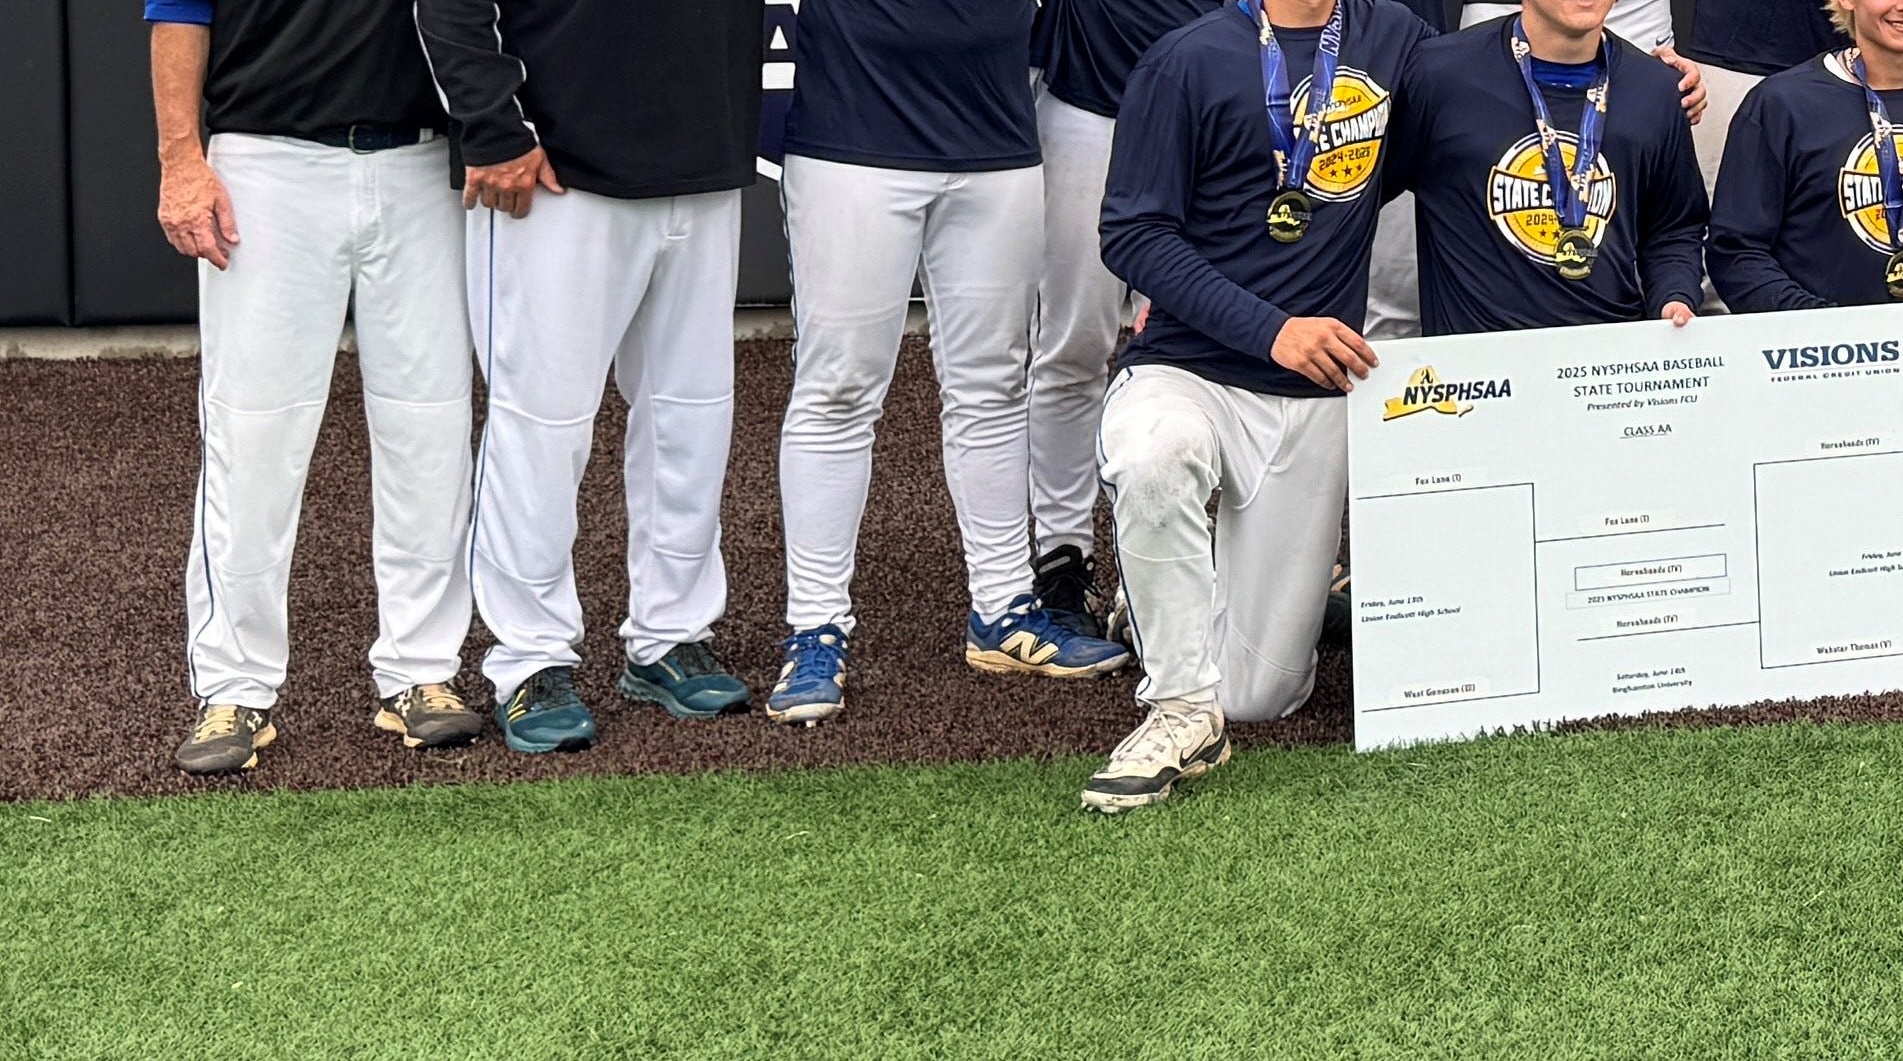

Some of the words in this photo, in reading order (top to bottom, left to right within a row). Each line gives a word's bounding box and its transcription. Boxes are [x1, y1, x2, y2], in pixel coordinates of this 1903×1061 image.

[1492, 179, 1540, 212] STATE
[1845, 177, 1881, 210] STAT
[1557, 365, 1587, 379] 2025
[1591, 360, 1660, 377] NYSPHSAA
[1663, 356, 1725, 371] BASEBALL
[1762, 340, 1900, 370] VISIONS
[1403, 379, 1512, 406] NYSPHSAA
[1574, 384, 1613, 398] STATE
[1616, 376, 1711, 395] TOURNAMENT
[1587, 400, 1632, 412] Presented
[1633, 398, 1645, 409] by
[1623, 426, 1655, 437] CLASS
[1657, 424, 1673, 434] AA
